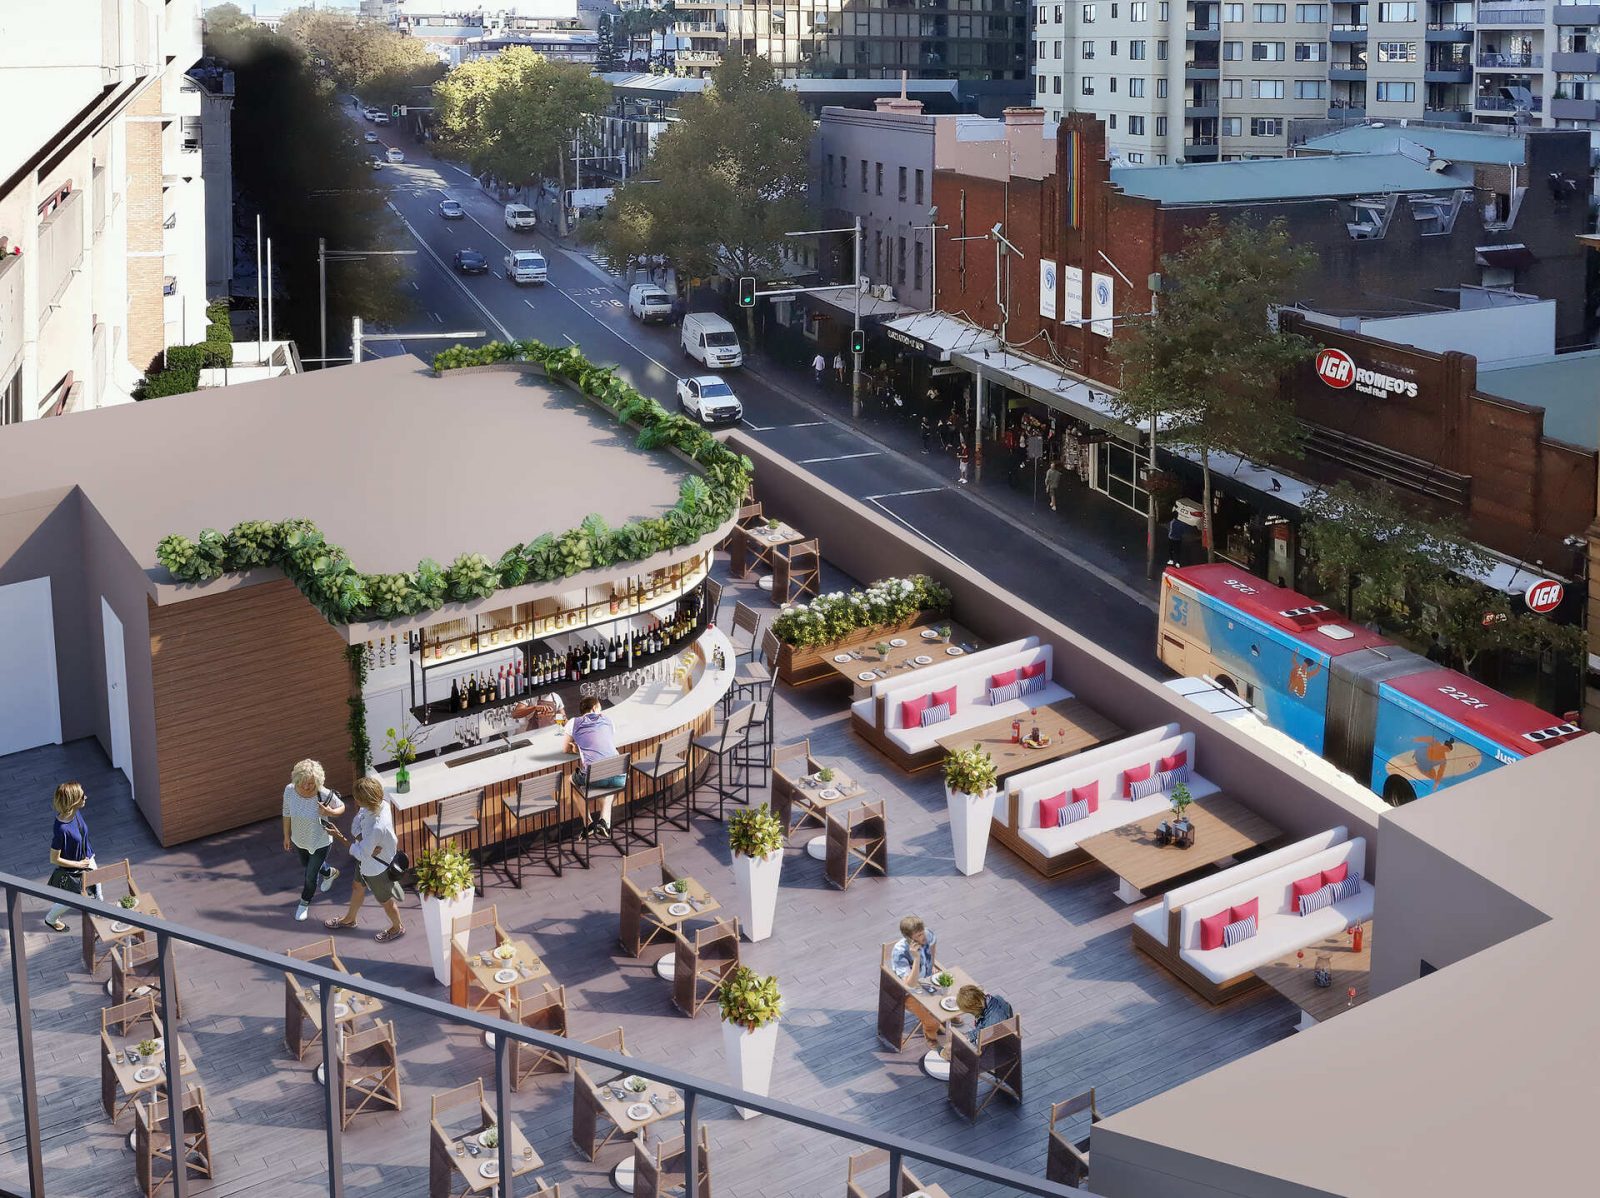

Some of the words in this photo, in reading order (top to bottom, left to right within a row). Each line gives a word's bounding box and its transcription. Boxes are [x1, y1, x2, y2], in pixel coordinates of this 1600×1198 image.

[590, 299, 624, 309] BUS
[1319, 355, 1351, 383] IGA
[1355, 382, 1373, 395] Food
[1356, 367, 1418, 398] ROMEO'S
[1532, 585, 1561, 607] IGA
